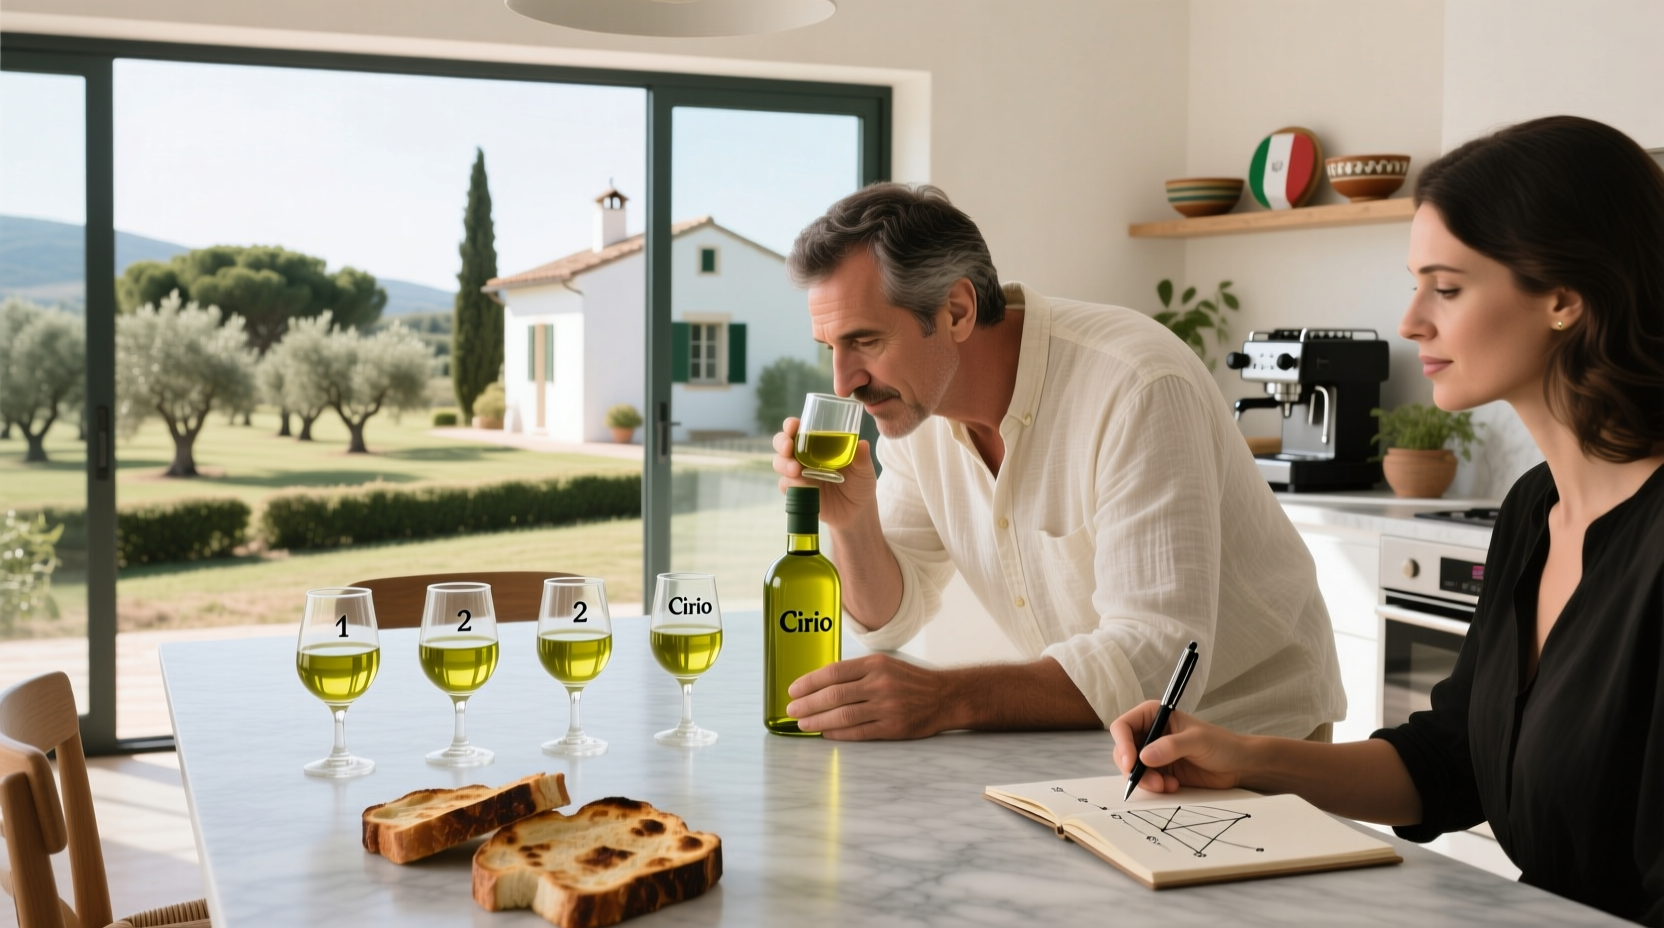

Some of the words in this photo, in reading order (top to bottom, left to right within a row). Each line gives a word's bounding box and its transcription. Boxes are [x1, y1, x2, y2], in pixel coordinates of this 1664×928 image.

[573, 602, 588, 623] 2
[668, 596, 713, 616] Cirio
[335, 614, 349, 638] 1
[457, 609, 472, 632] 2
[779, 610, 833, 633] Cirio
